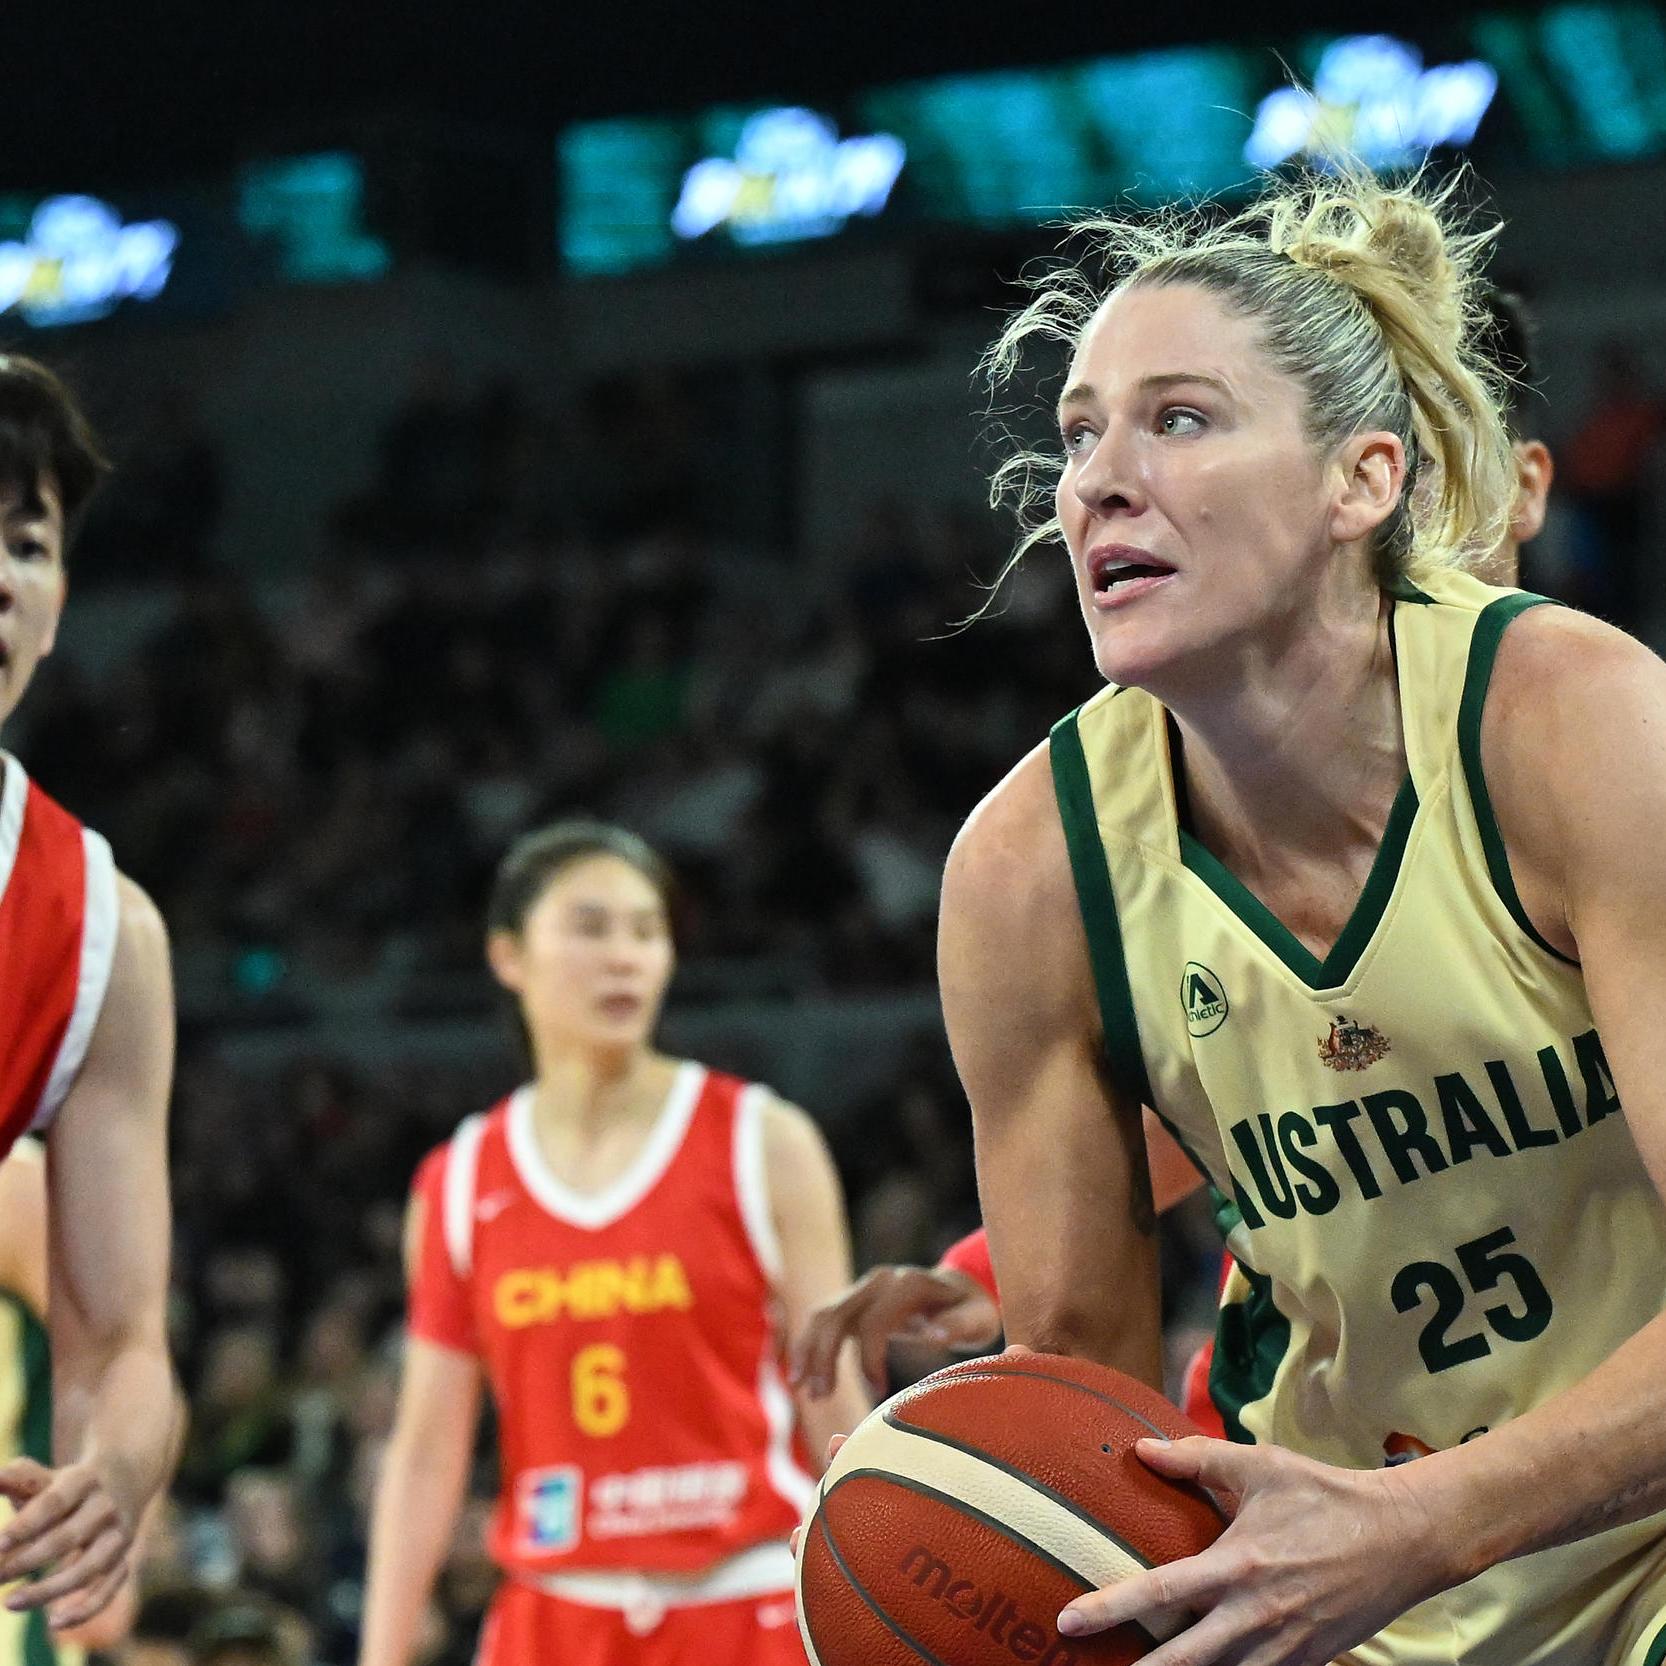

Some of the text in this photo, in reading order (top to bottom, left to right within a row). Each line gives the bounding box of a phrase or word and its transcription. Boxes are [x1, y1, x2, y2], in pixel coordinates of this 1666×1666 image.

[493, 1253, 695, 1330] CHINA
[1391, 1226, 1553, 1374] 25
[570, 1342, 630, 1438] 6
